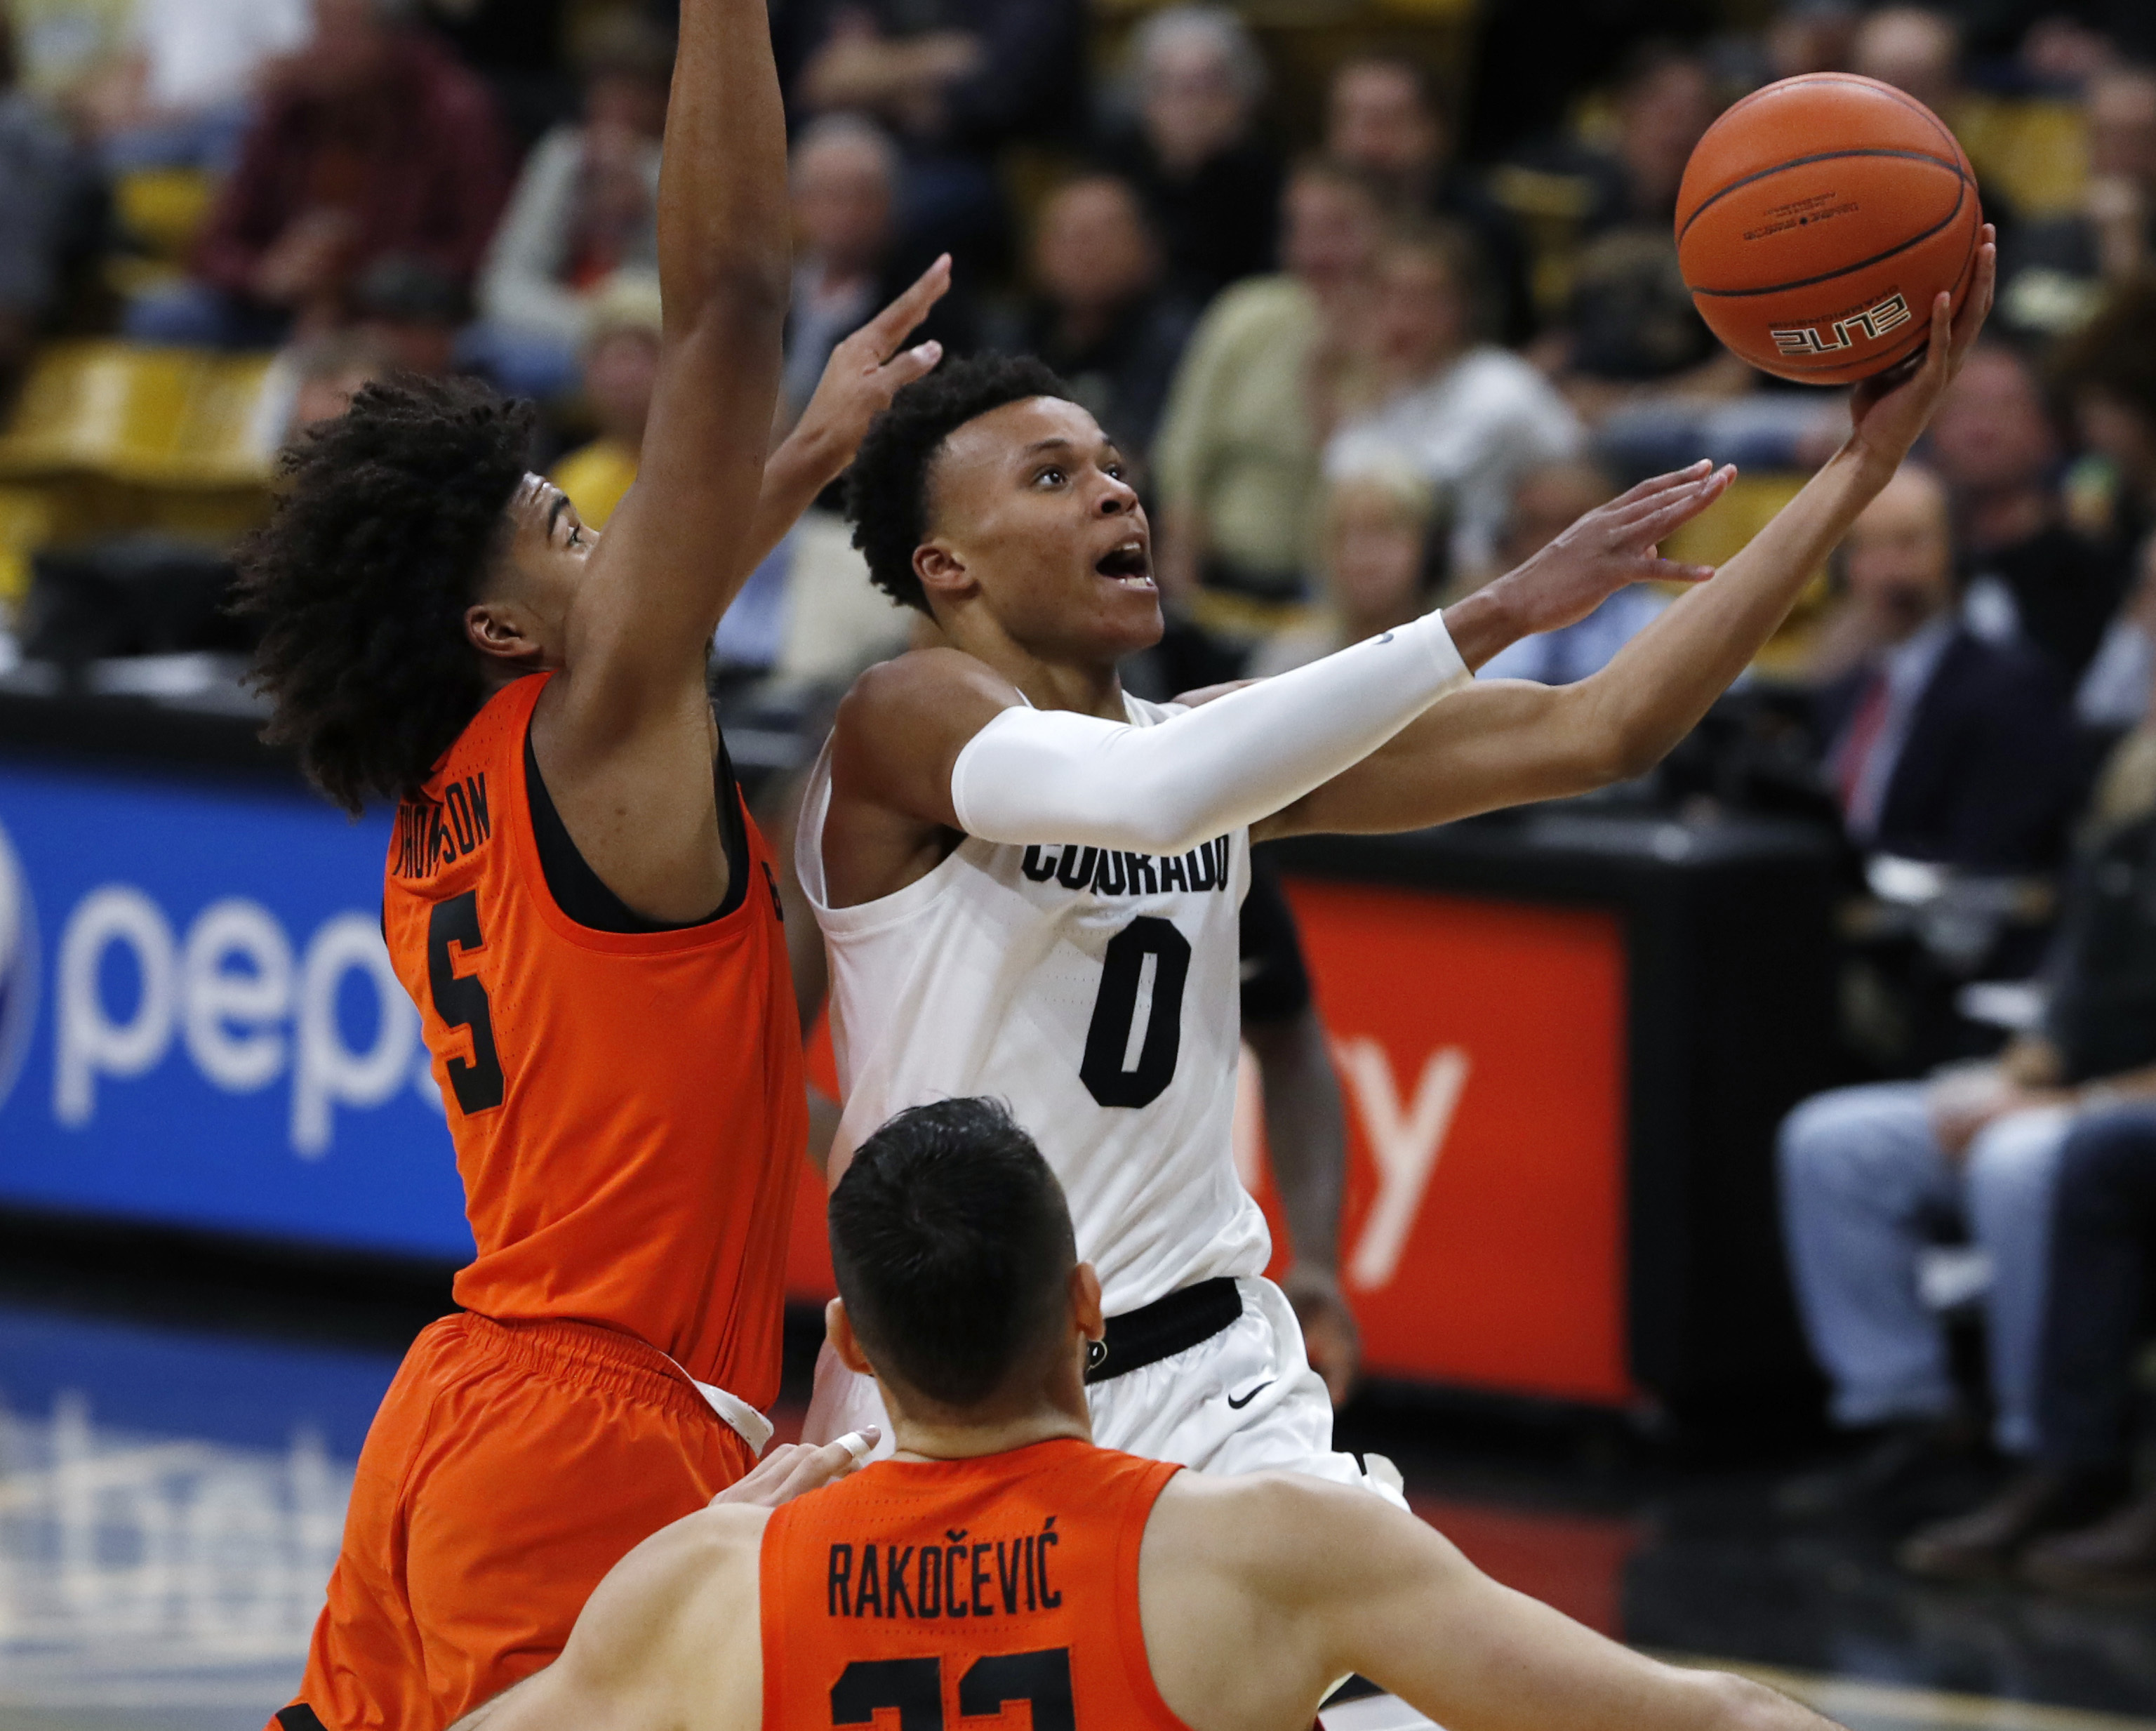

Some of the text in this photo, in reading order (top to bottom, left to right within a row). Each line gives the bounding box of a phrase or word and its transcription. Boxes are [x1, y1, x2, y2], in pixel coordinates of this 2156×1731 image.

[1771, 293, 1912, 356] ELITE
[1021, 834, 1230, 896] COORADO
[54, 883, 445, 1162] pep
[427, 890, 507, 1116] 5
[1079, 915, 1192, 1110] 0
[828, 1516, 1063, 1618] RAKOČEVIĆ
